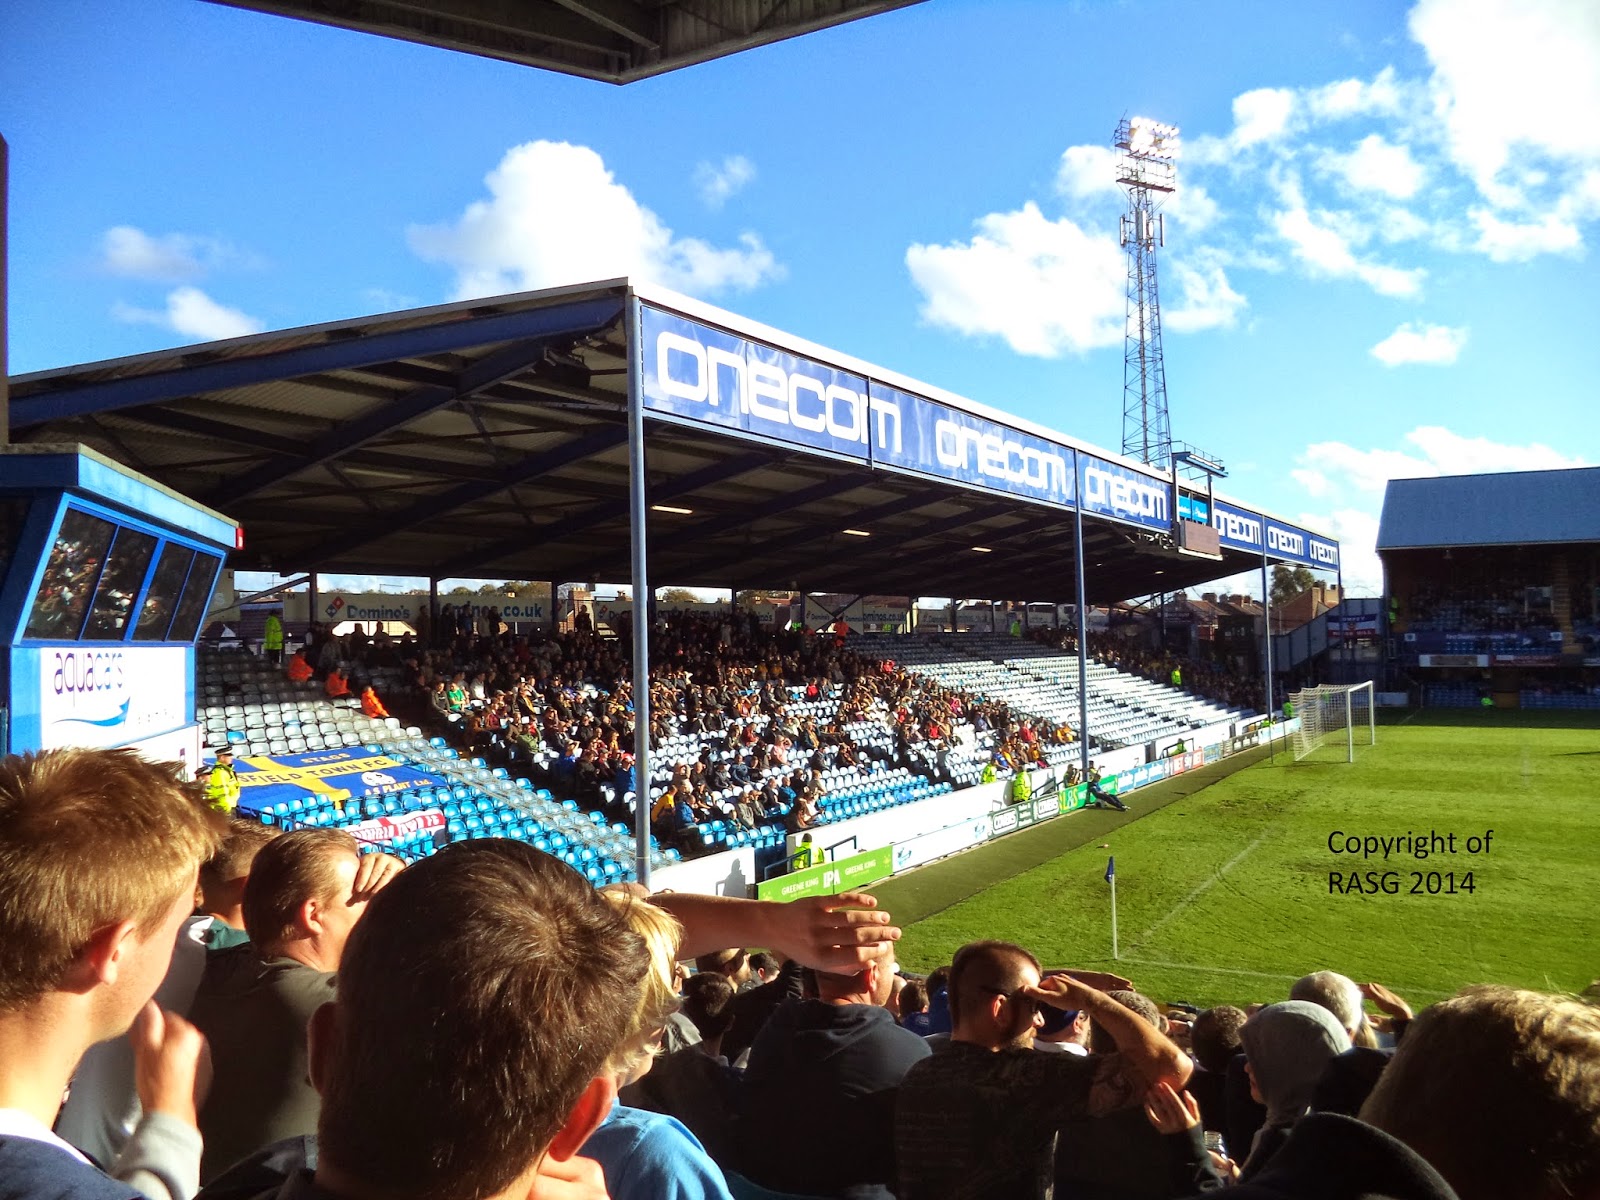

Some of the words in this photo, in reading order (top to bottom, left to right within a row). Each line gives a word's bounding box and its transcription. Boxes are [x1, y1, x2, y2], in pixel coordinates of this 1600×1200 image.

[656, 331, 902, 453] onecom
[935, 419, 1067, 494] onecom
[1084, 466, 1167, 522] onecom
[1213, 509, 1261, 545] onecom
[1267, 526, 1304, 557] onecom
[1309, 539, 1338, 565] onecom
[346, 605, 410, 619] Domino's
[863, 610, 907, 622] ominos.co.uk
[54, 653, 123, 703] aquacars
[237, 772, 302, 783] SFIELD
[305, 764, 362, 776] TOWN
[363, 759, 388, 768] FC
[382, 781, 411, 793] PLANT
[781, 882, 805, 896] GREENE
[805, 877, 819, 889] KING
[823, 869, 841, 889] IPA
